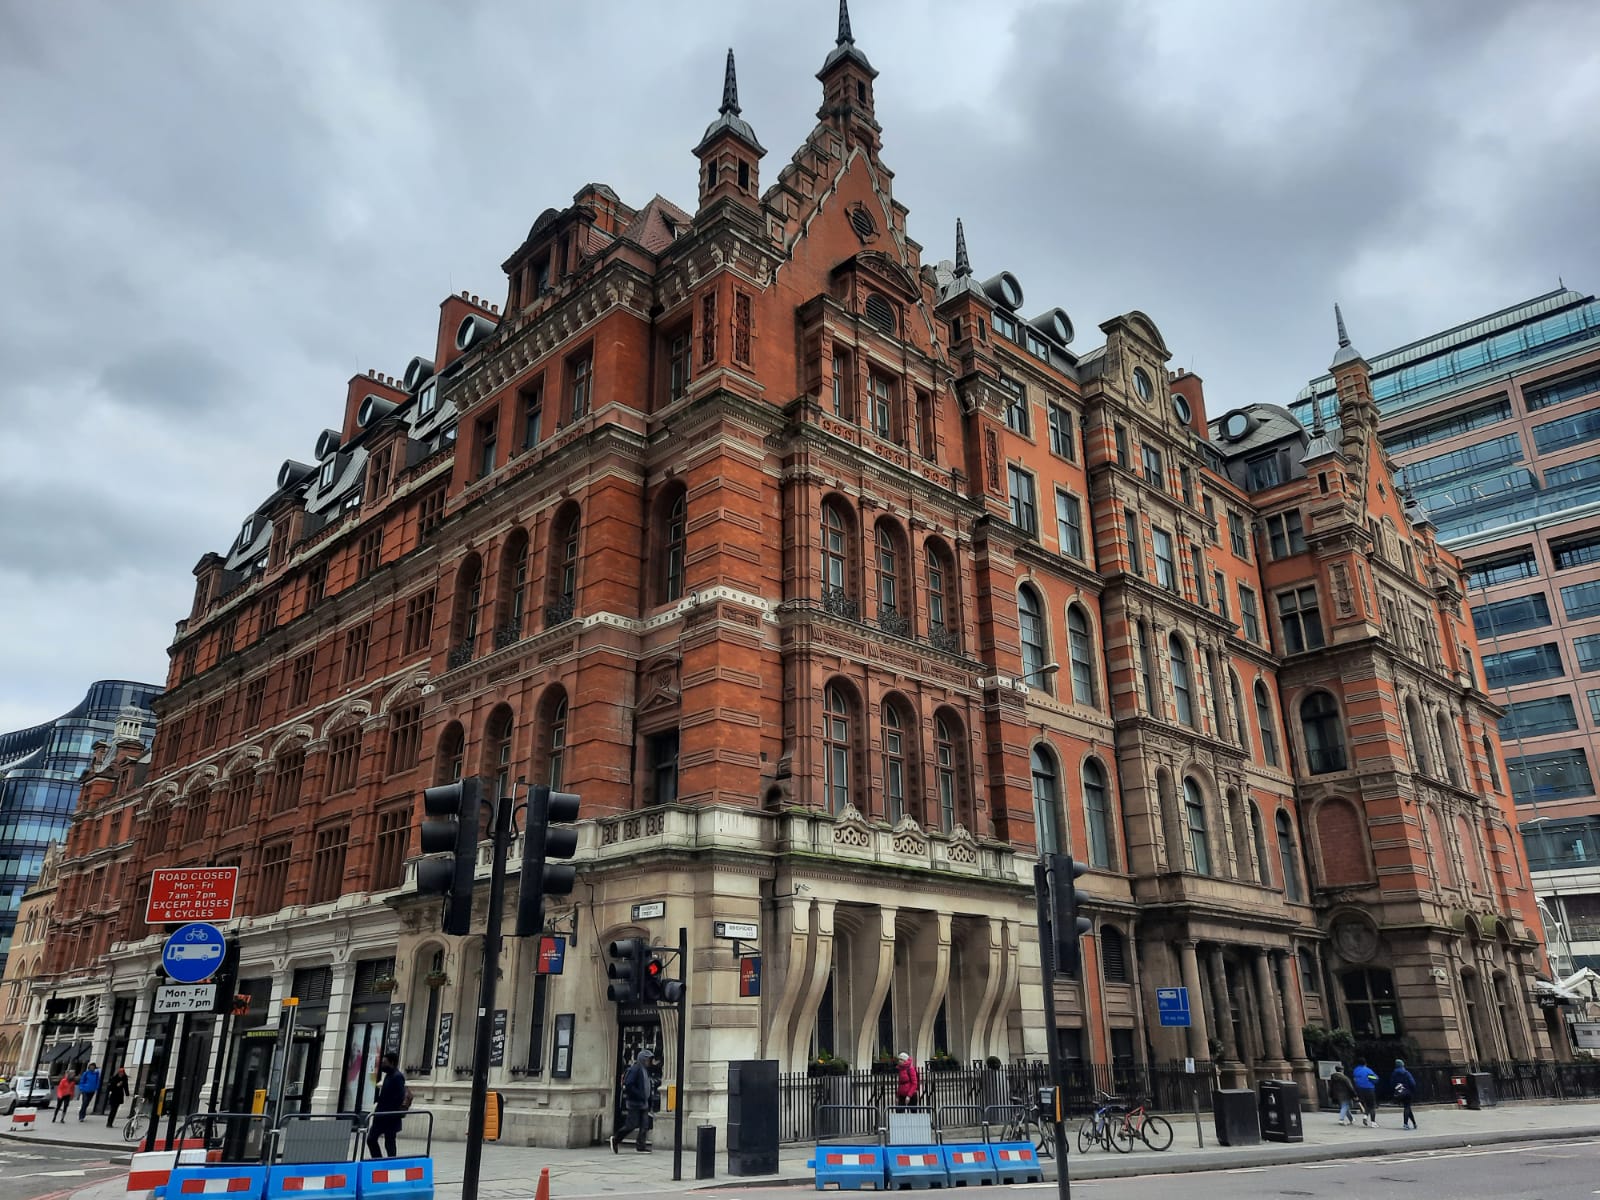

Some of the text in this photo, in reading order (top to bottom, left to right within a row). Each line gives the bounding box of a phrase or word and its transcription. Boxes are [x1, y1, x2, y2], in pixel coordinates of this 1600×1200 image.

[159, 871, 232, 881] ROAD CLOSED
[174, 882, 195, 890] Mon
[201, 881, 214, 889] Fri
[153, 899, 229, 909] EXCEPT BUSES
[165, 909, 214, 918] & CYCLES
[165, 989, 187, 998] Mon
[194, 987, 208, 996] Fri
